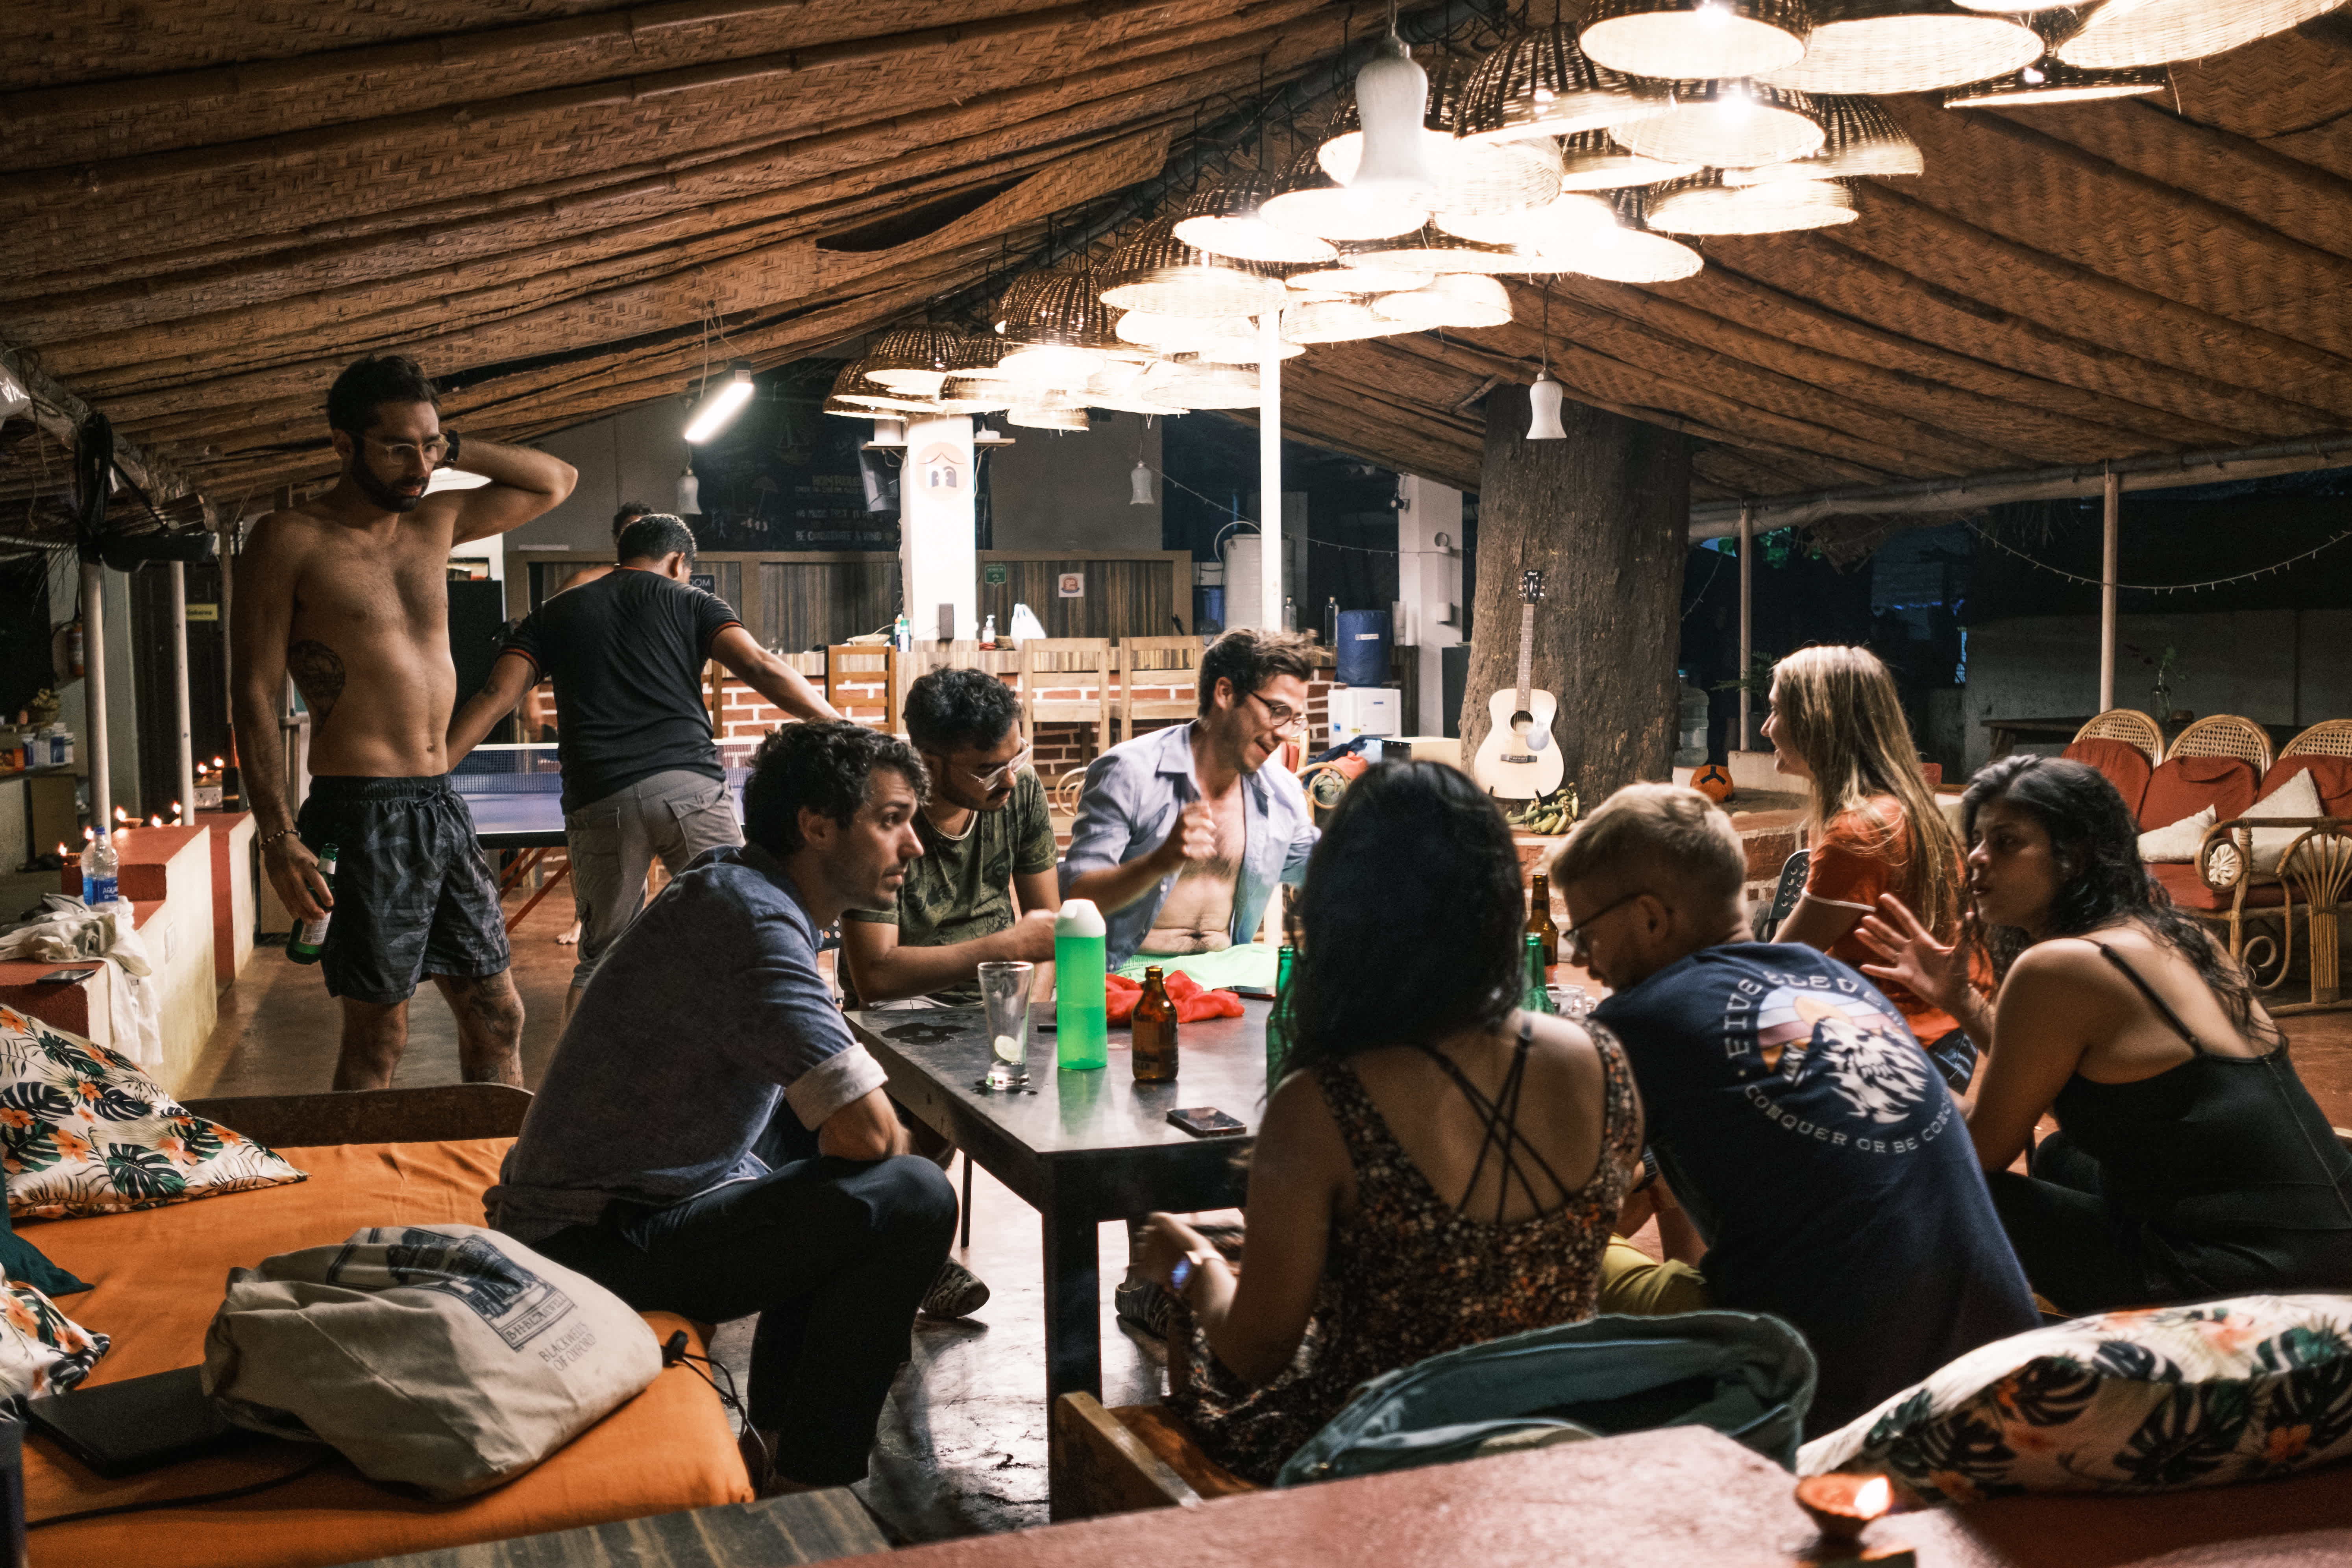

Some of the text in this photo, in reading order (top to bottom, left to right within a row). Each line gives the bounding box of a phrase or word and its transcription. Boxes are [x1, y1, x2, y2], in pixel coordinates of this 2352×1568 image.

[1855, 1137, 1887, 1154] OR
[1892, 1137, 1918, 1155] BE
[553, 1355, 568, 1371] OF
